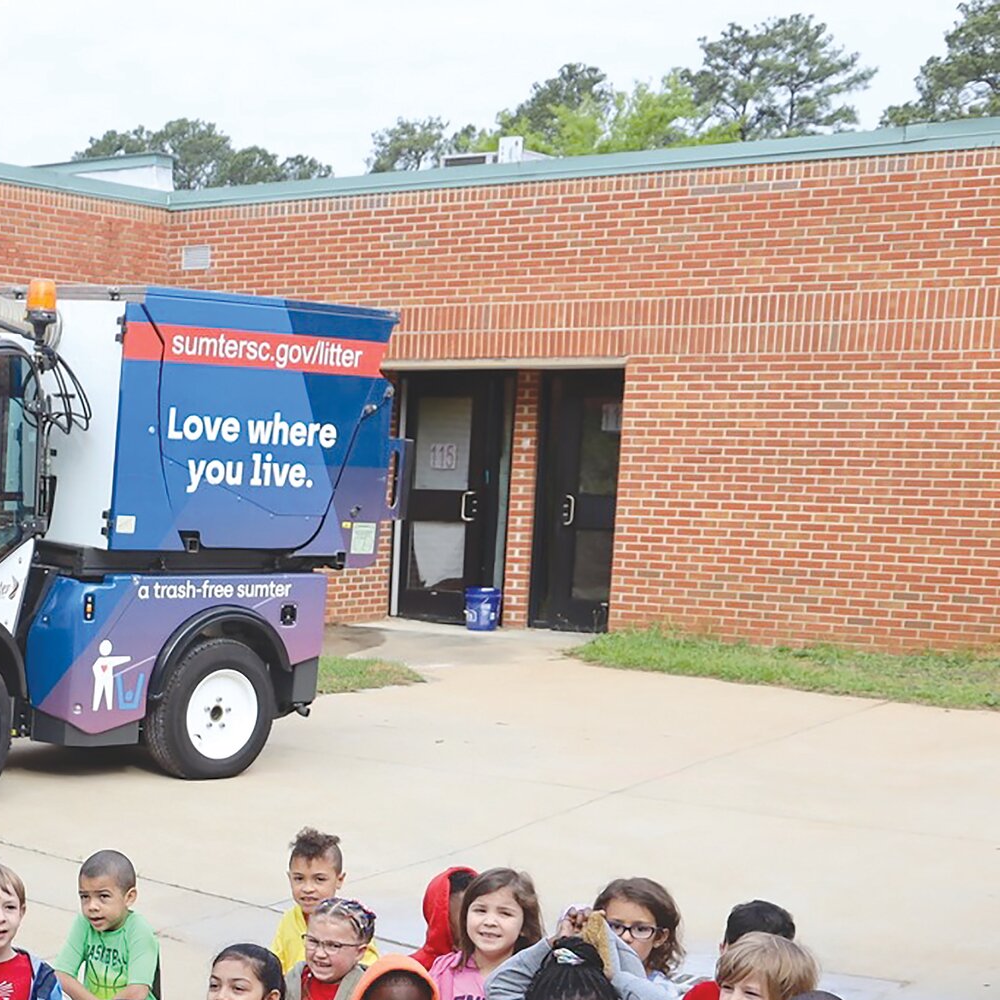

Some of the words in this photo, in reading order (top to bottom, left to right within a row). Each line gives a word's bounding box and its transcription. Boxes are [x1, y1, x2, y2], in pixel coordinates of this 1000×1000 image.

[171, 333, 363, 369] sumtersc.gov/litter
[167, 406, 241, 442] Love
[247, 411, 338, 449] where
[185, 458, 243, 493] you
[250, 453, 314, 488] live.
[138, 585, 149, 599] a
[153, 579, 234, 599] trash-free
[236, 581, 292, 598] sumter
